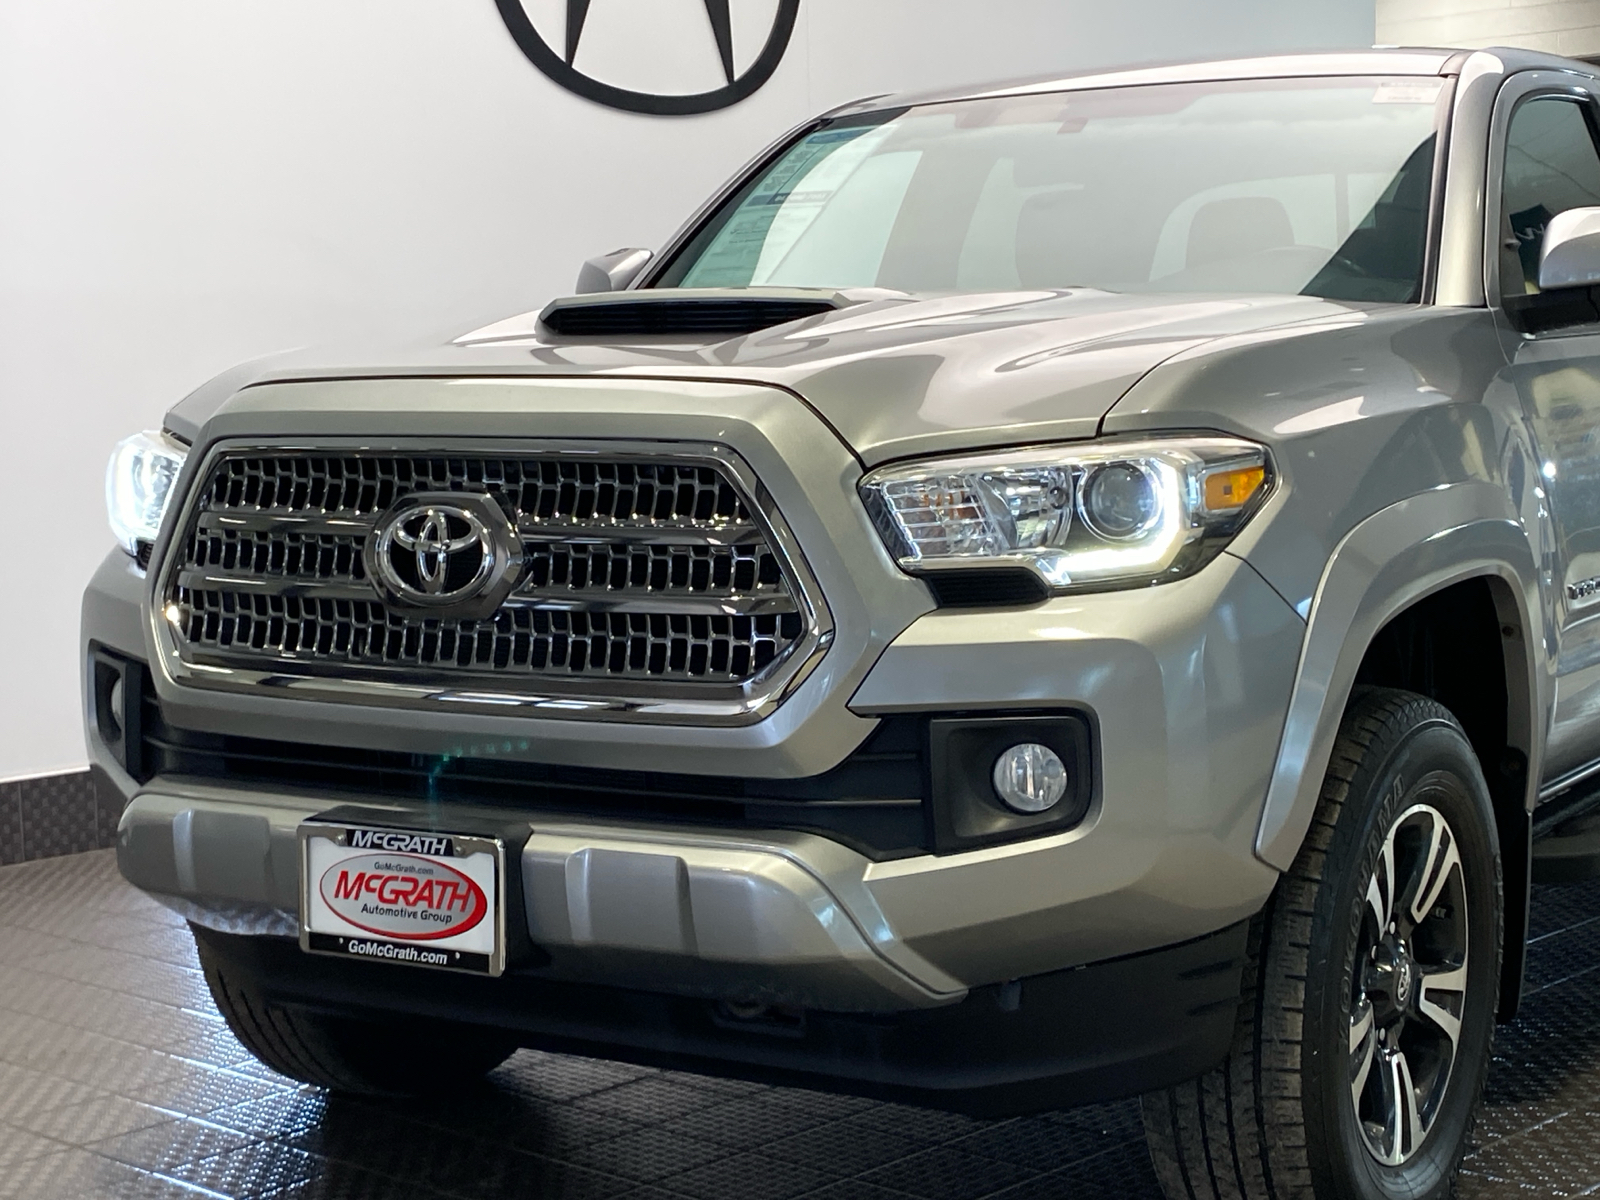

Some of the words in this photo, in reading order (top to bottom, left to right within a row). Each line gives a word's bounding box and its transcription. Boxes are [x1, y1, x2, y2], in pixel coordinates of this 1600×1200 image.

[374, 861, 434, 875] GoMcGrath.com
[361, 903, 418, 919] Automotive
[420, 911, 452, 925] Group
[348, 940, 448, 965] GoMcGrath.com
